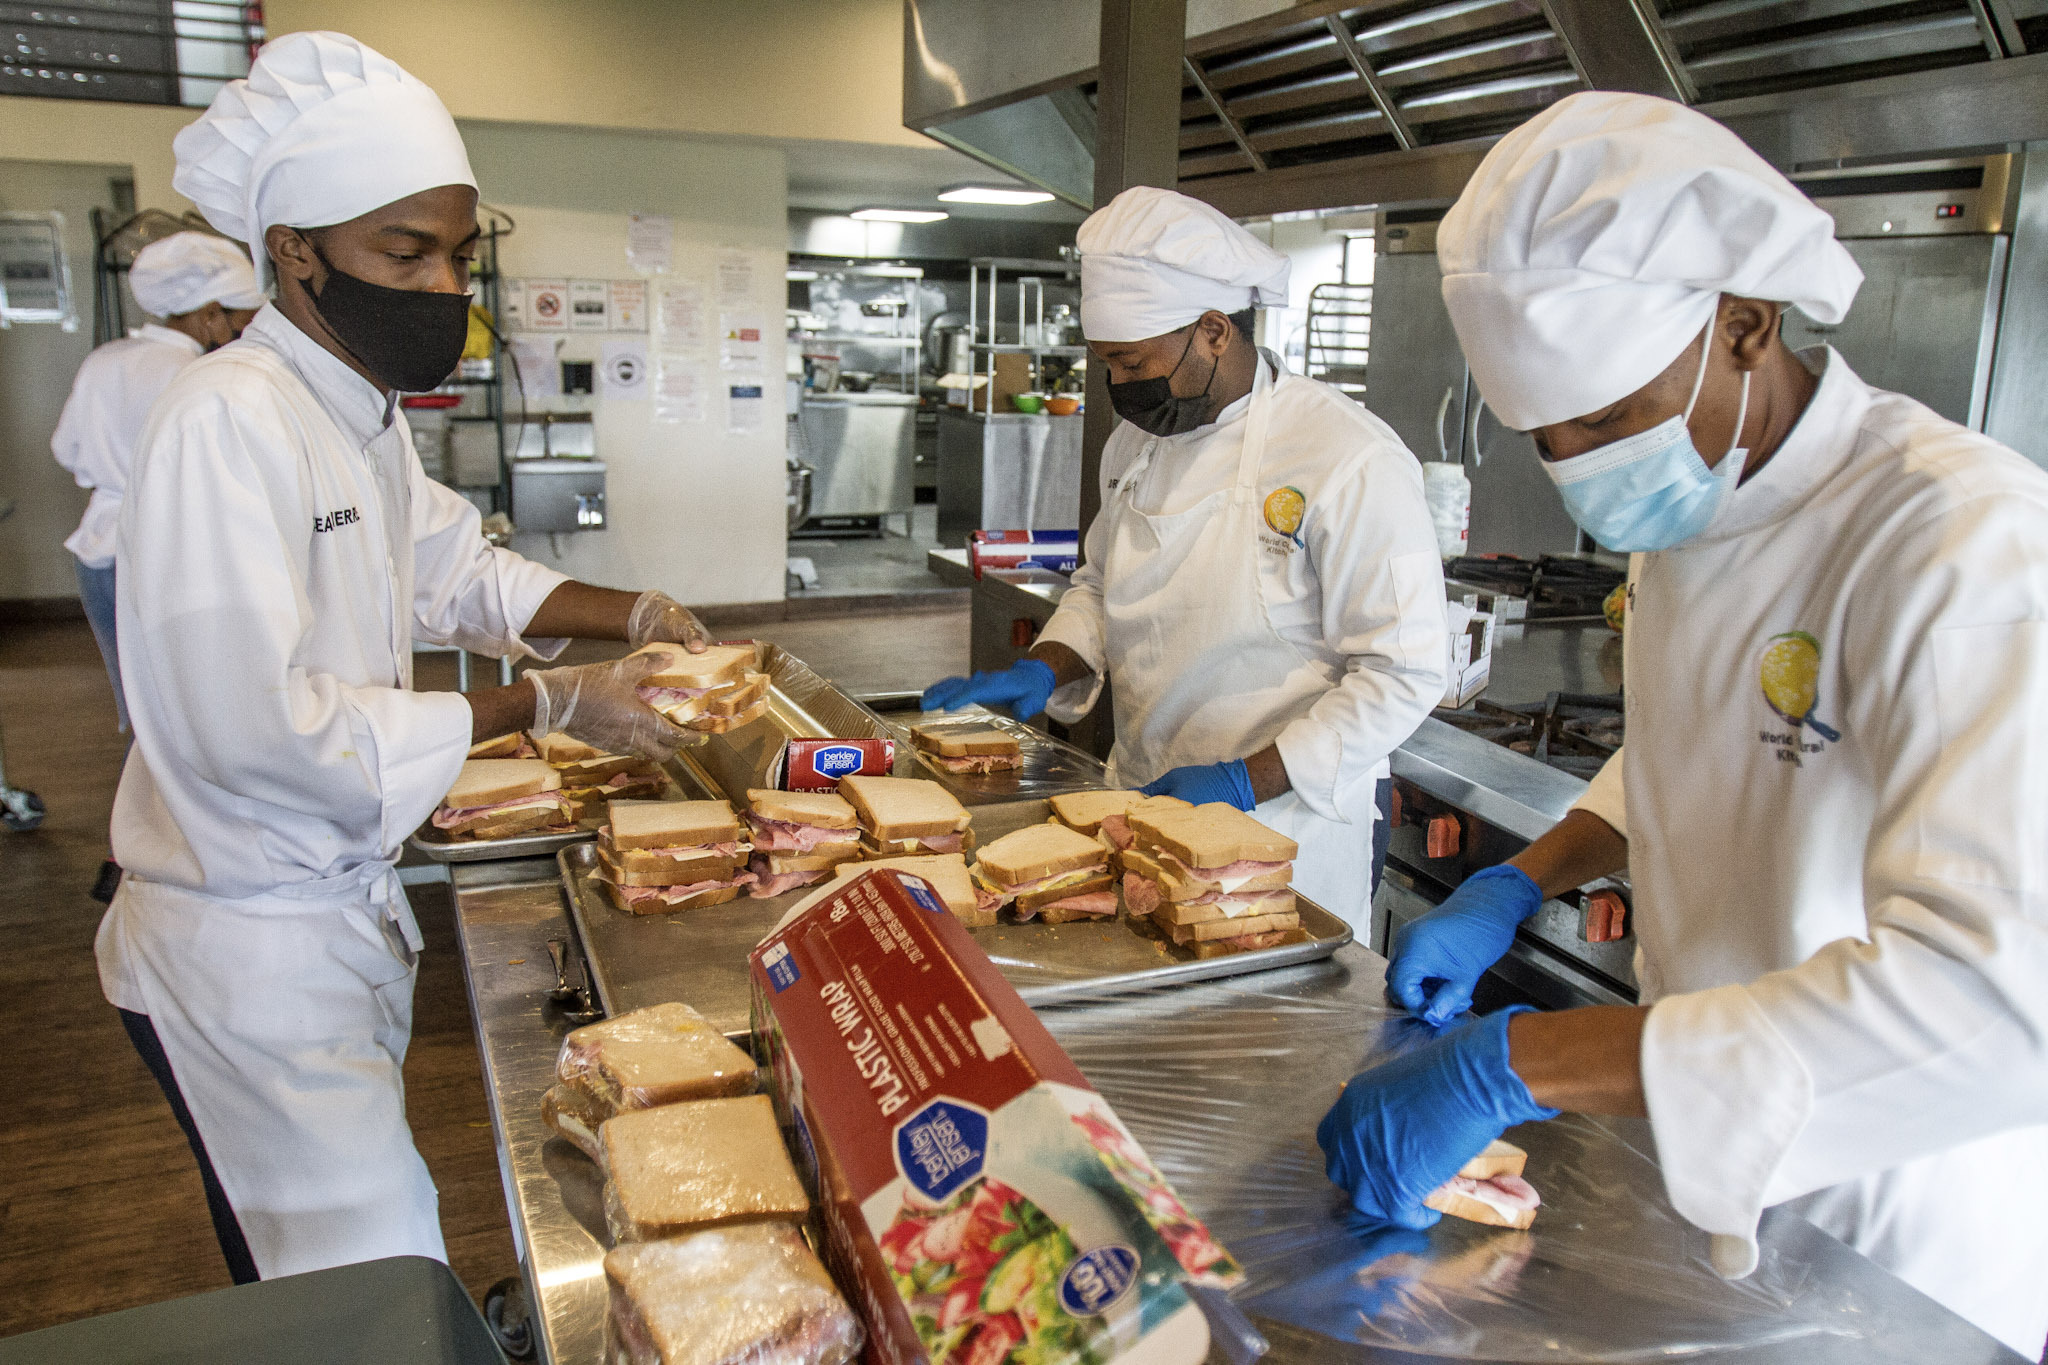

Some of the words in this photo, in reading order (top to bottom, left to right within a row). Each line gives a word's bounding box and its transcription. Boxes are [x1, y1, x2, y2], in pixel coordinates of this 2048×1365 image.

[823, 761, 854, 771] jensen
[824, 751, 856, 761] berkley
[849, 962, 865, 981] FILM
[857, 977, 874, 997] WRAP
[819, 980, 864, 1036] WRAP
[867, 994, 886, 1016] FOOD
[878, 1012, 899, 1038] GRADE
[847, 1027, 911, 1118] PLASTIC
[892, 1034, 931, 1090] PROFESSIONAL
[928, 1112, 980, 1168] jensen
[906, 1125, 950, 1190] berkley
